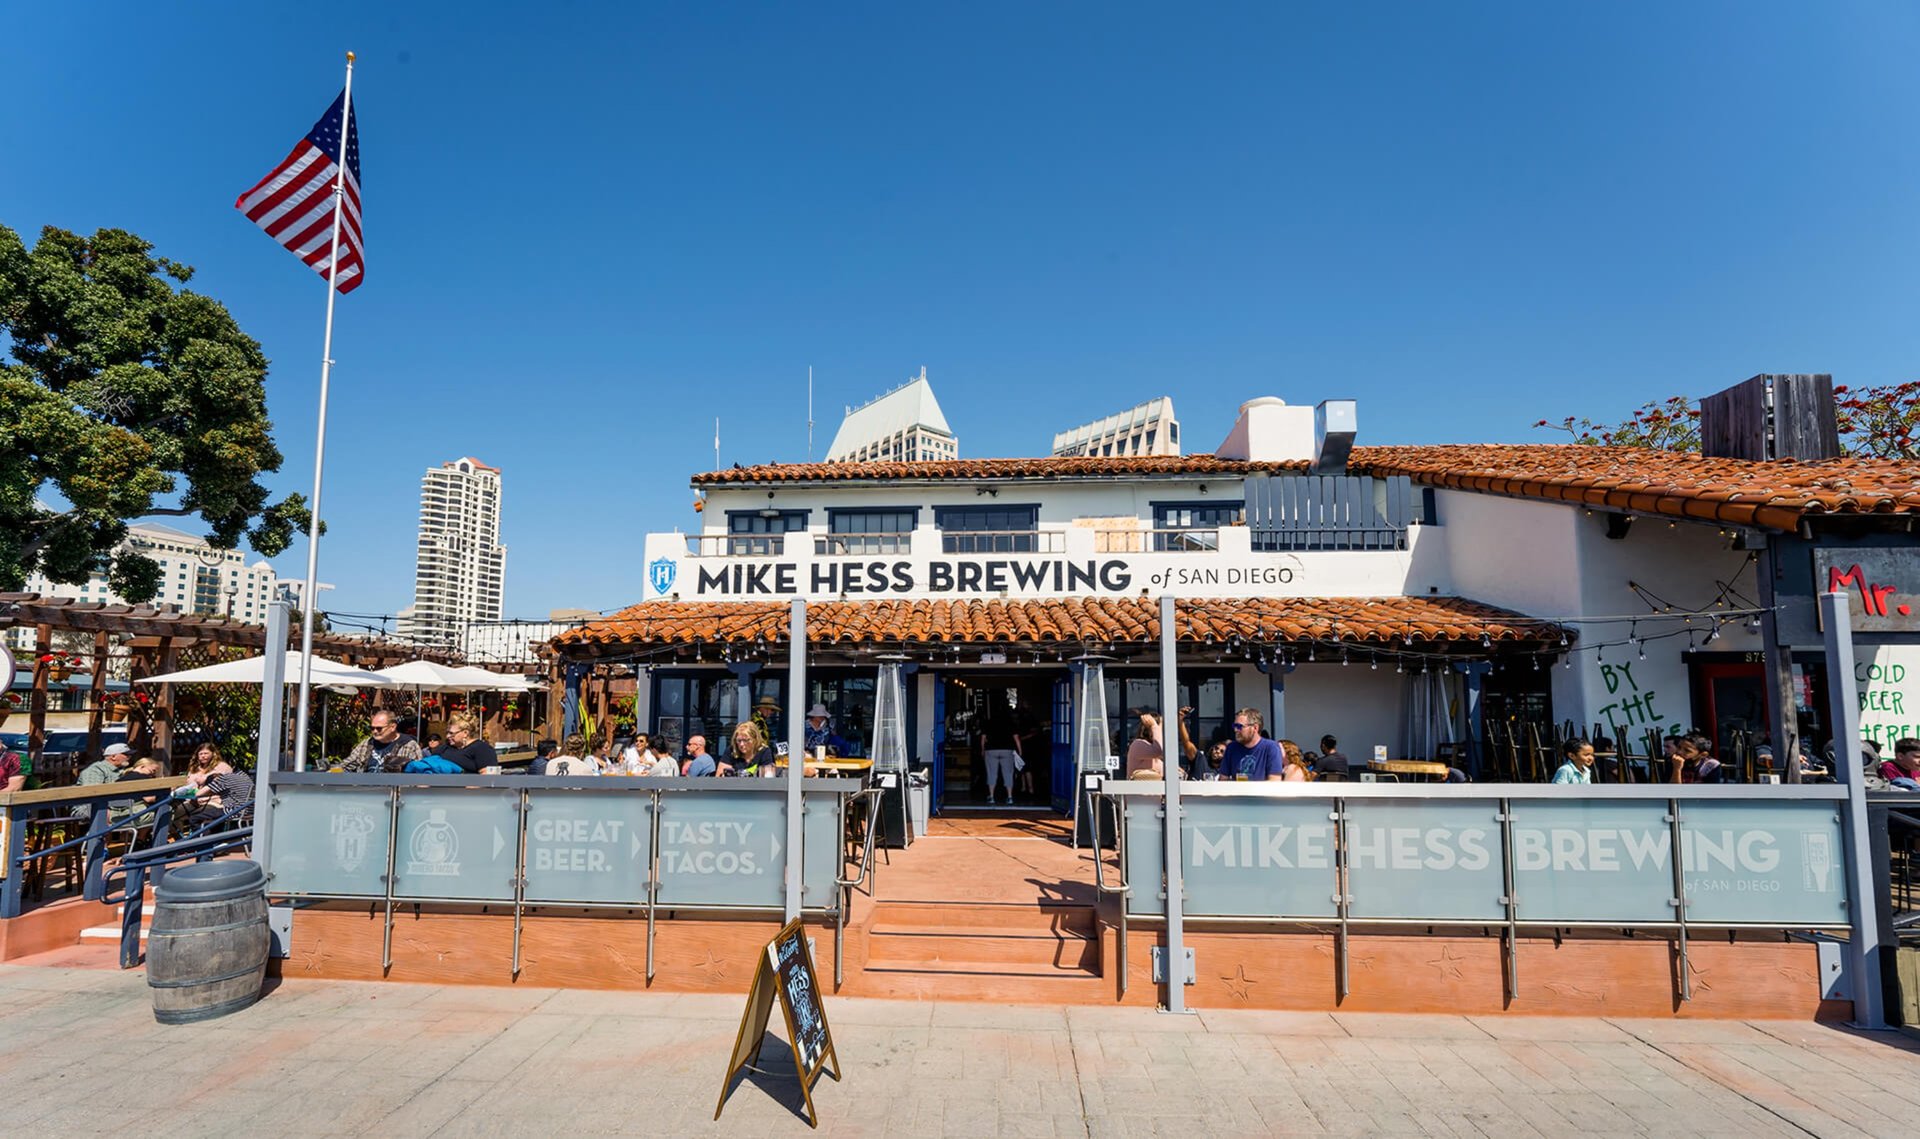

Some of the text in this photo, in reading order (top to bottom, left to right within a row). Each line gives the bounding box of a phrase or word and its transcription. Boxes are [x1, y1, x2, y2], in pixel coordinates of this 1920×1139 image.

[697, 560, 1293, 594] MIKE HESS BREWING of SAN DIEGO
[1829, 564, 1911, 616] Mr.
[1600, 661, 1638, 694] BY
[1854, 662, 1905, 684] COLD
[1599, 691, 1664, 736] THE
[1858, 691, 1904, 715] BEER
[778, 743, 789, 753] 39
[1107, 757, 1118, 767] 43
[331, 814, 375, 834] HESS
[533, 820, 624, 842] GREAT
[663, 821, 753, 845] TASTY
[535, 848, 613, 872] BEER.
[1192, 825, 1328, 868] MIKE
[1347, 826, 1490, 870] HESS
[1515, 829, 1780, 873] BREWING
[664, 851, 764, 875] TACOS.
[1684, 879, 1780, 893] of SAN DIEGO
[787, 966, 809, 1006] HESS
